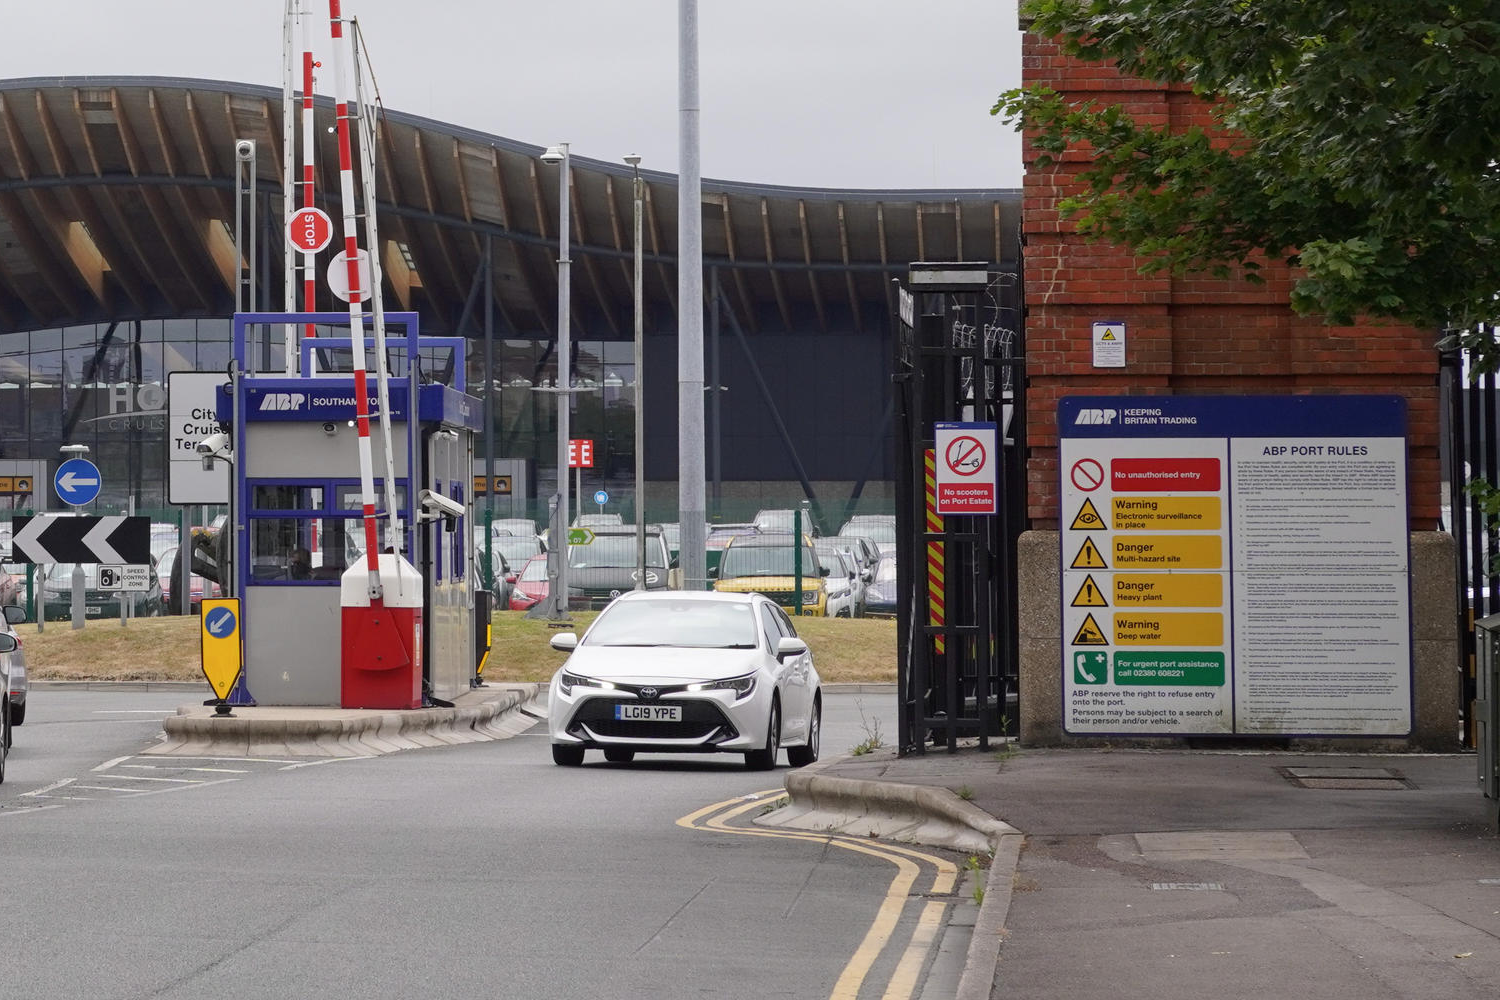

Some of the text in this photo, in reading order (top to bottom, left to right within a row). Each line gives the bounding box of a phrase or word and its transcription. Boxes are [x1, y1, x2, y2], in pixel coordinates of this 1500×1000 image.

[304, 214, 316, 246] STOP
[259, 393, 380, 410] ABP SOUTHAMTO
[1074, 409, 1117, 425] ABP
[581, 444, 591, 465] E
[1262, 446, 1368, 456] ABP PORT RULES
[1180, 472, 1201, 480] entry
[1115, 500, 1158, 510] Warning
[1116, 542, 1154, 553] Danger
[1117, 581, 1155, 591] Danger
[1117, 620, 1159, 630] Warning
[1133, 661, 1158, 669] urgent
[1160, 661, 1176, 669] port
[1137, 690, 1156, 698] right
[1107, 699, 1125, 707] port.
[625, 707, 676, 719] LG19 YPE
[1137, 709, 1166, 717] subject
[1092, 718, 1120, 726] person
[1122, 717, 1148, 725] and/or
[1150, 717, 1180, 725] vehicle.
